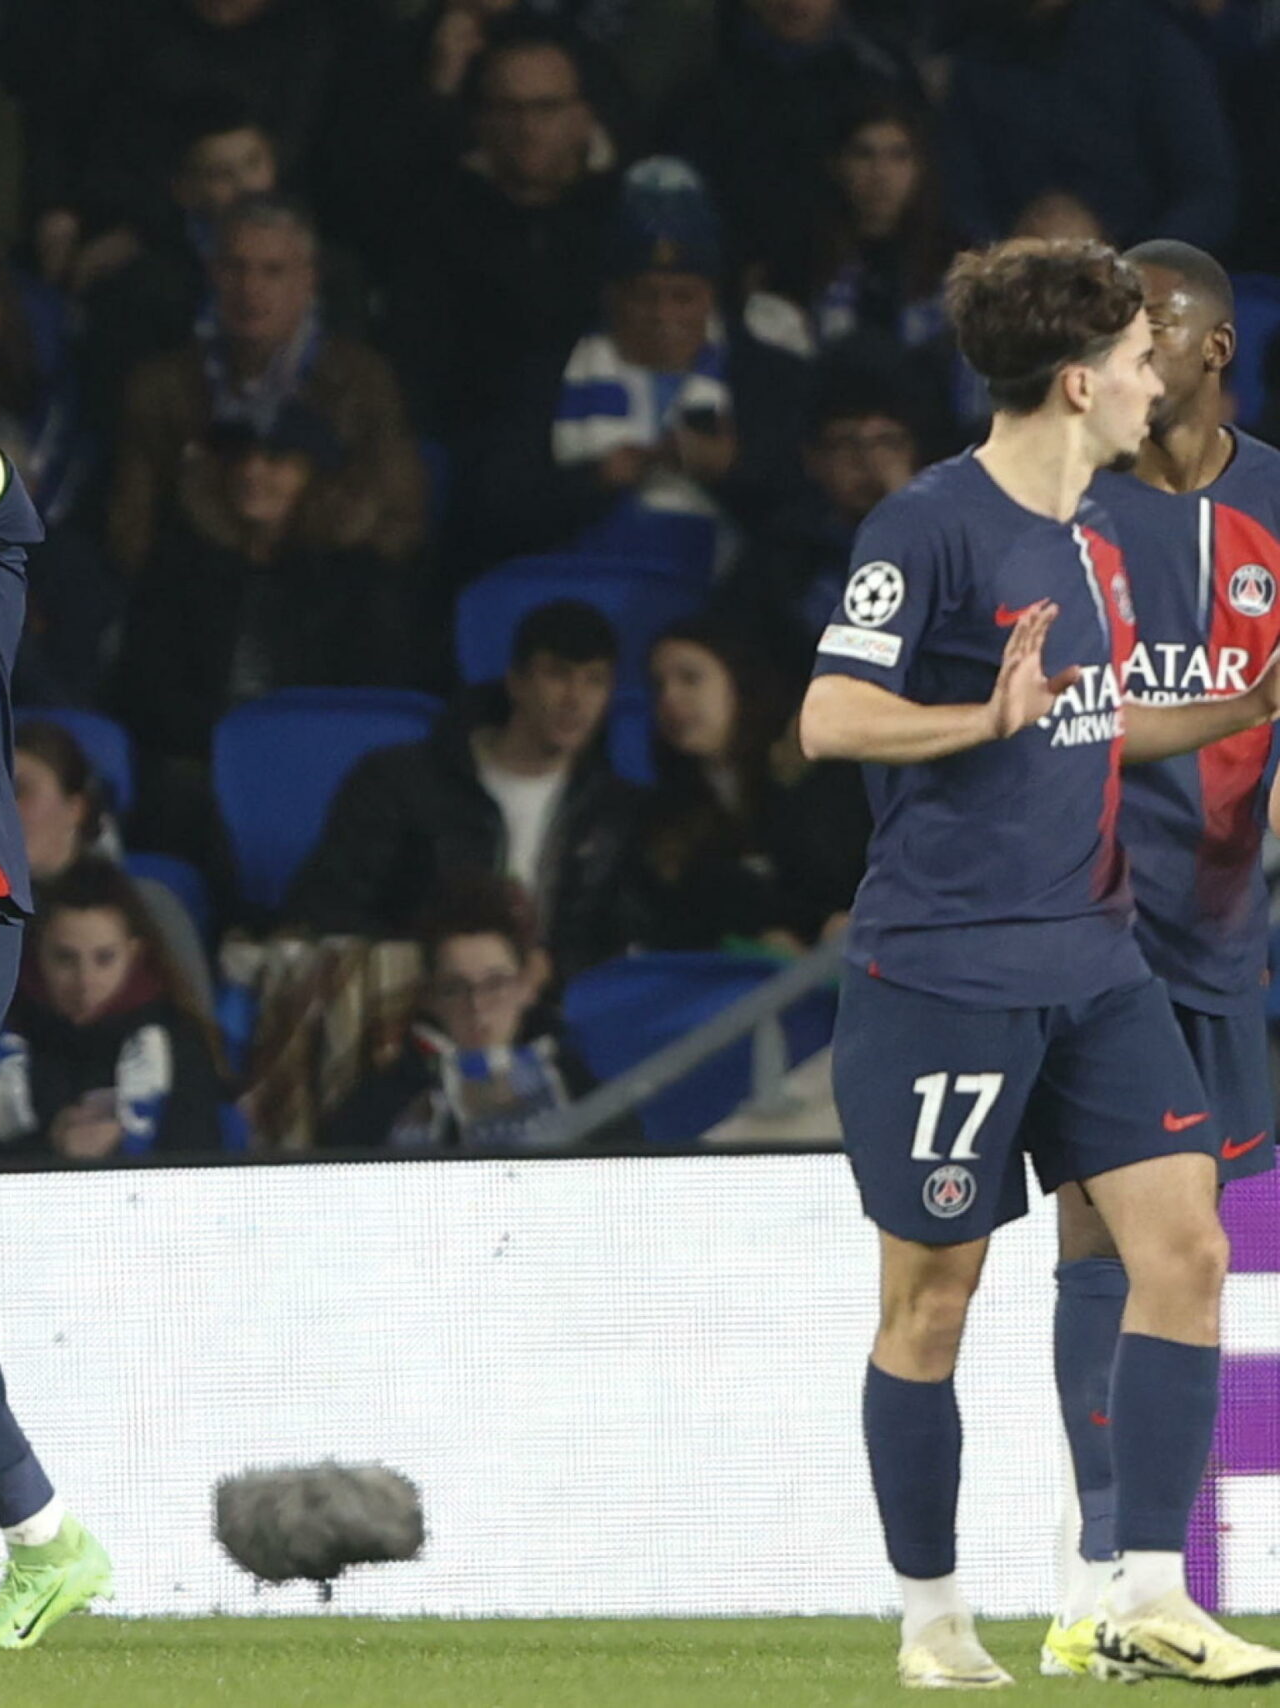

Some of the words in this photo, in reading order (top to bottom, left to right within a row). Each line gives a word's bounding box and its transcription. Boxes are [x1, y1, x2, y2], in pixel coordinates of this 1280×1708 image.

[1037, 661, 1127, 729] ATA
[1121, 641, 1249, 691] ATAR
[910, 1072, 1005, 1160] 17
